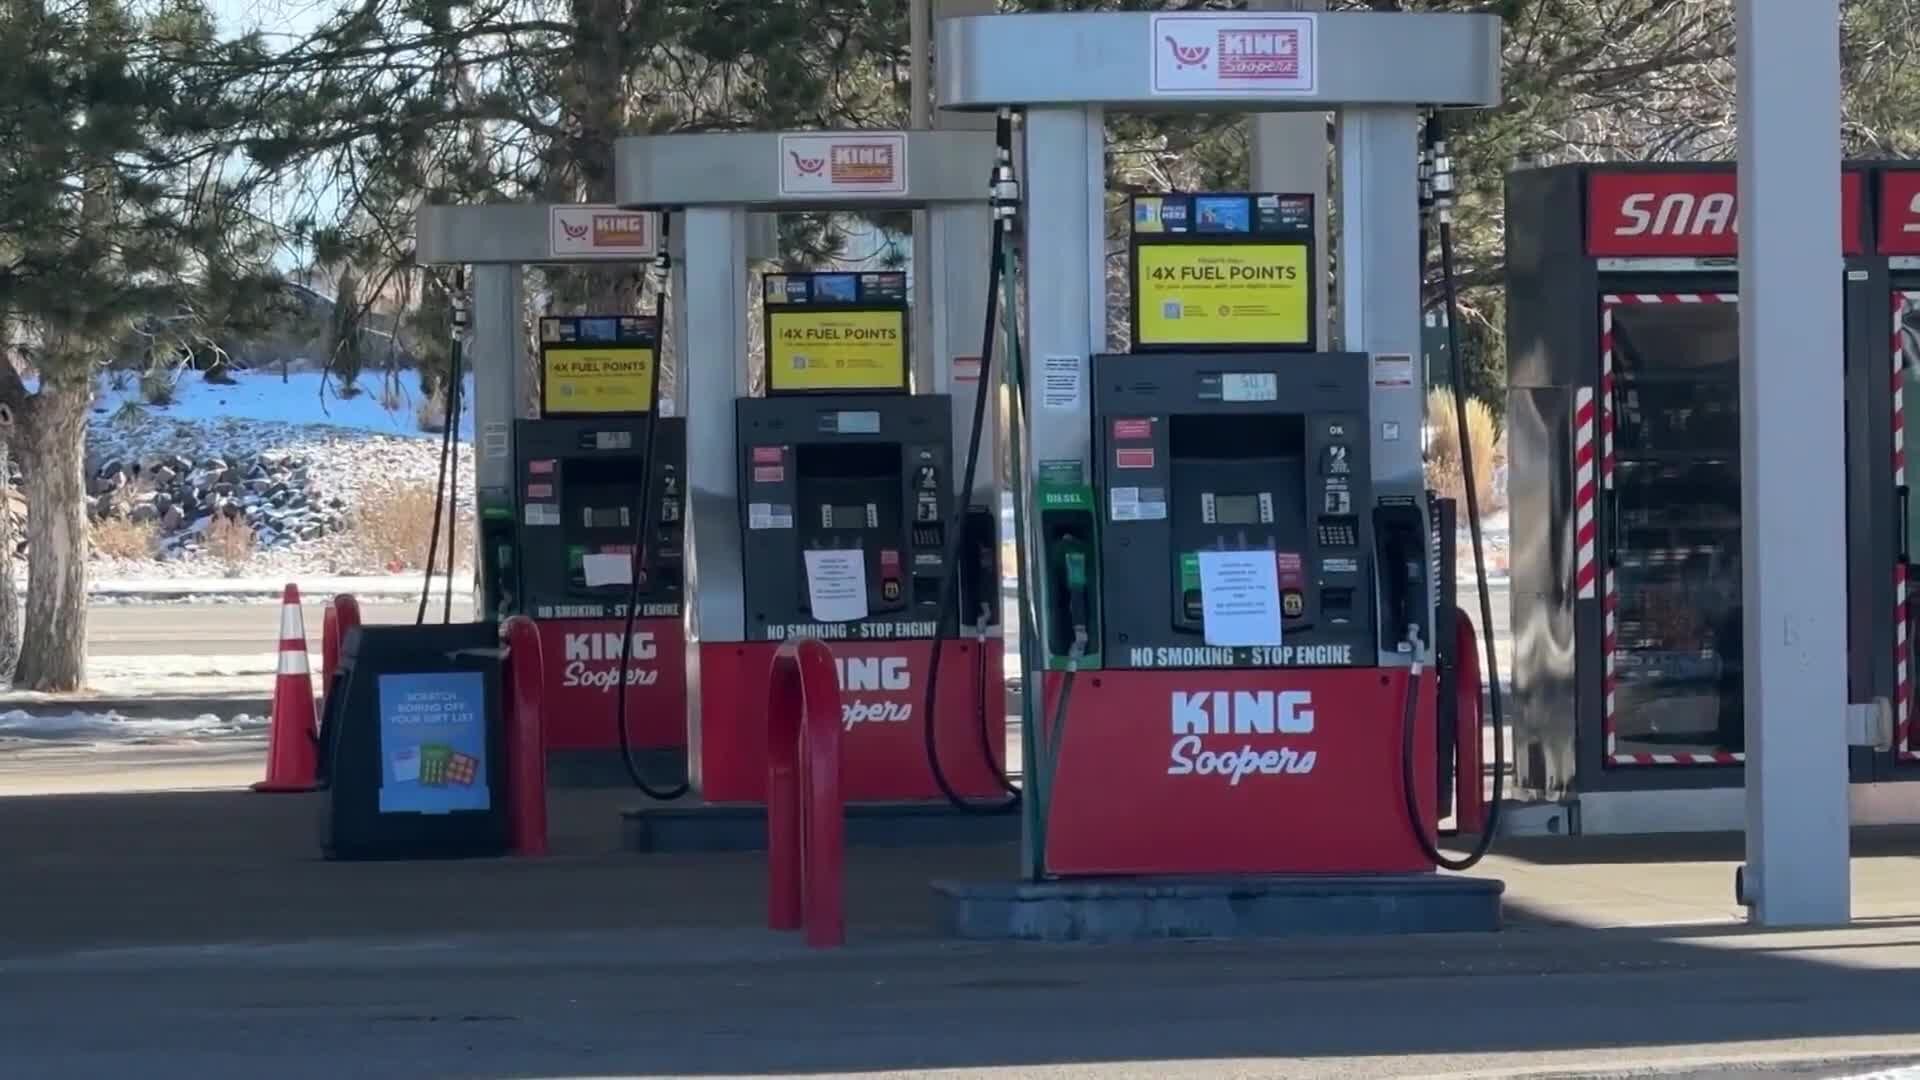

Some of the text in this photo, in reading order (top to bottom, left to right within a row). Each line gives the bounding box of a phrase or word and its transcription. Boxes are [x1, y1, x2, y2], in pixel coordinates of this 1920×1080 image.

[1224, 33, 1293, 56] KING
[835, 147, 890, 165] KING
[1614, 192, 1738, 235] SNA
[596, 217, 641, 233] KING
[1152, 265, 1175, 280] 4X
[1181, 265, 1225, 280] FUEL
[1230, 265, 1297, 280] POINTS
[784, 327, 897, 340] 4X FUEL POINTS
[553, 361, 646, 372] 4X FUEL POINTS
[1045, 493, 1082, 503] DIESEL
[538, 603, 680, 617] NO SMOKING STP ENGINE
[767, 624, 785, 640] NO
[787, 623, 847, 639] SMOKING
[860, 622, 893, 638] STOP
[565, 632, 657, 661] KING
[1131, 644, 1352, 667] NO SMOKING STOP ENGINE
[562, 661, 658, 693] Soopers
[834, 657, 911, 691] ING
[1171, 690, 1314, 735] KING
[1167, 734, 1317, 786] Soopers
